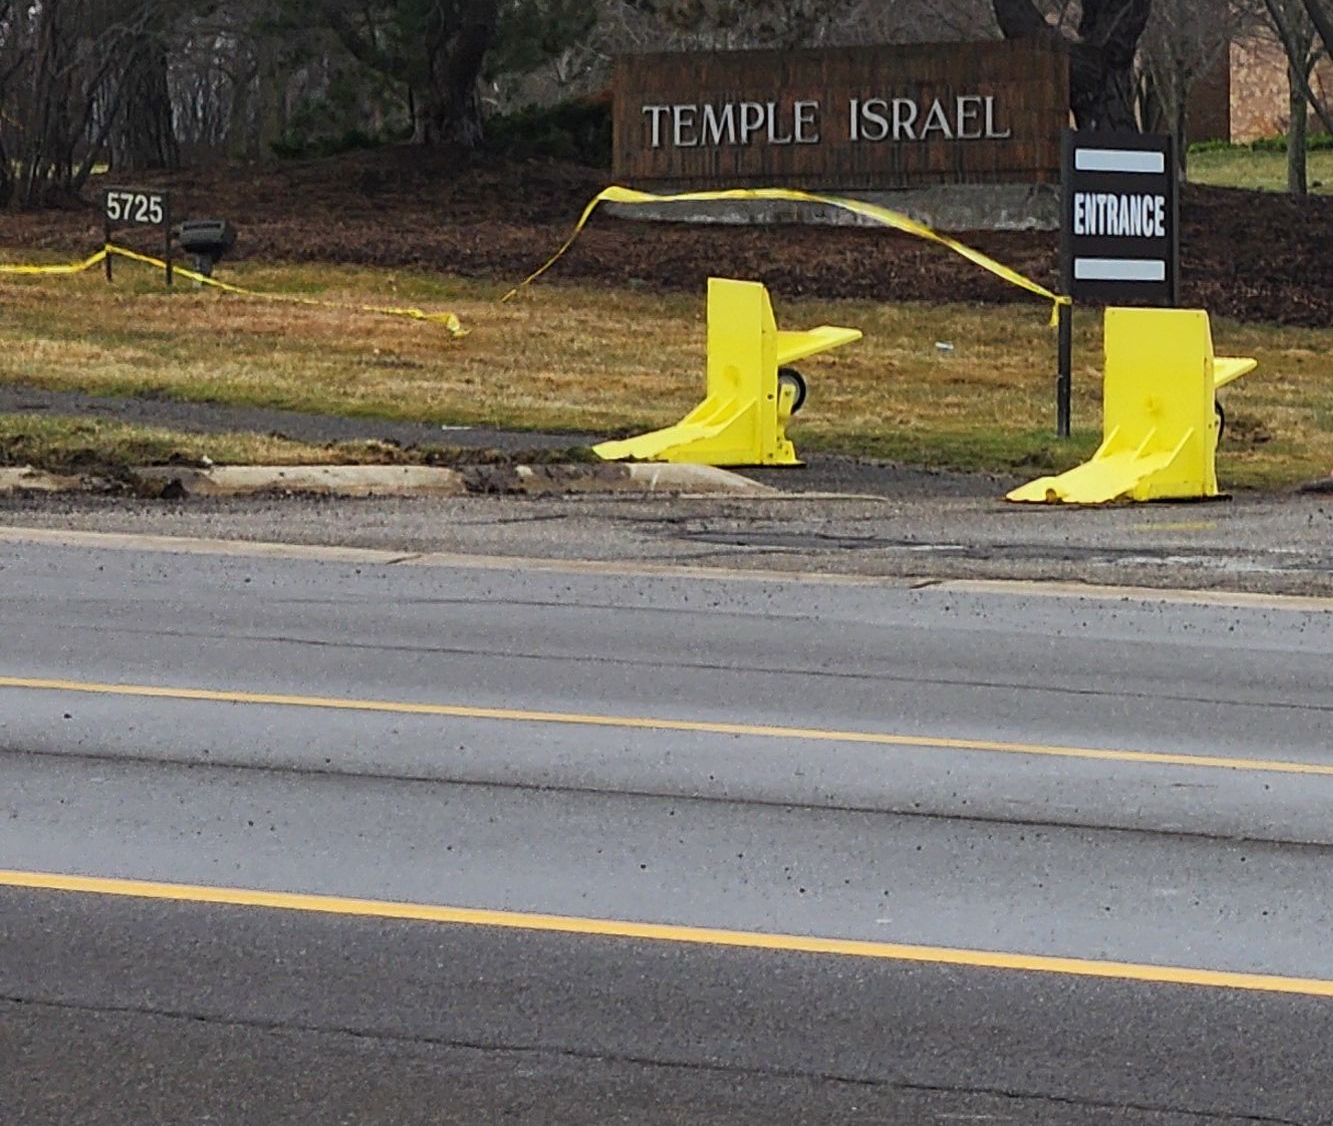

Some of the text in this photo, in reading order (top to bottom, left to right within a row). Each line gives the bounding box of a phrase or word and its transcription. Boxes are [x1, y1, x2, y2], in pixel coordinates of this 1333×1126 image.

[642, 95, 1011, 148] TEMPLE ISRAEL
[107, 192, 163, 223] 5725
[1073, 192, 1165, 238] ENTRANCE
